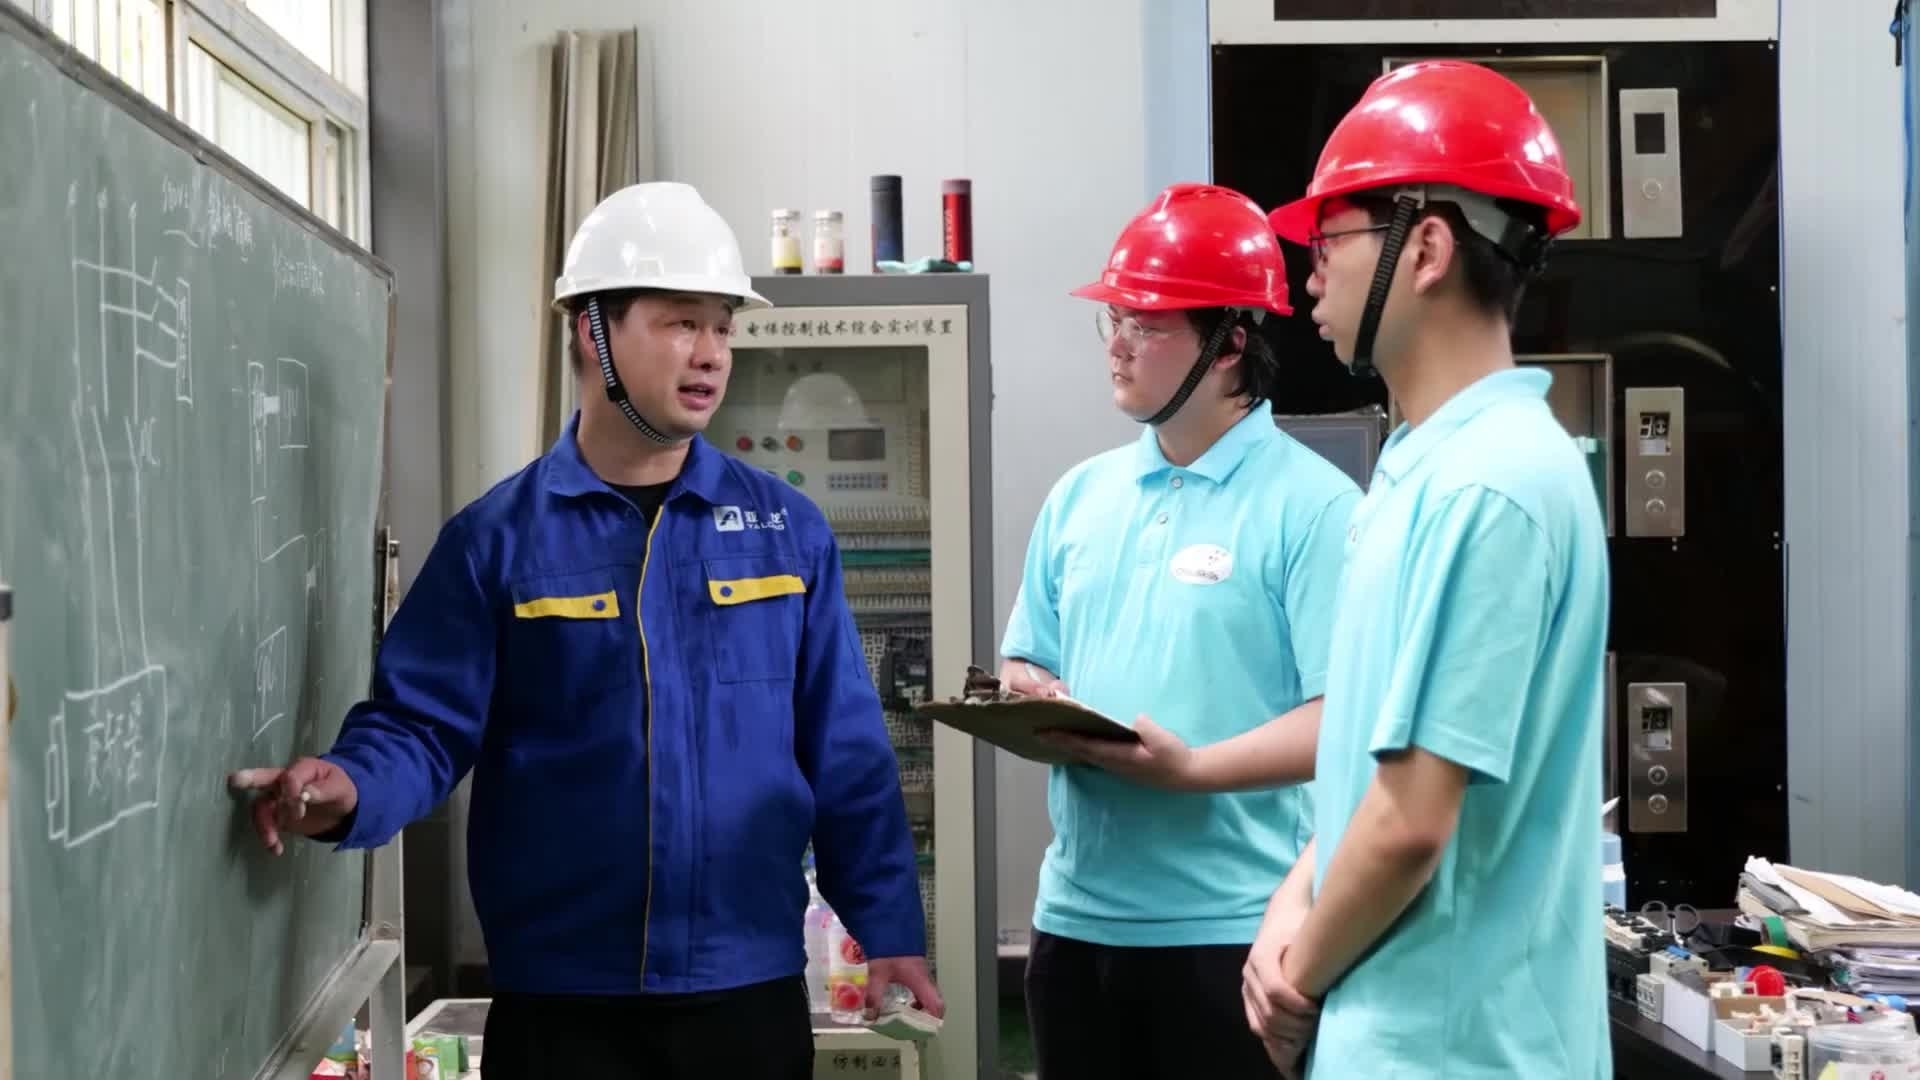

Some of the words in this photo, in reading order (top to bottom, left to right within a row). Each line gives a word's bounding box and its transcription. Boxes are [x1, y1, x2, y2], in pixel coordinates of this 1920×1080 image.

[746, 317, 954, 337] 电梯控制技术综合实训装置
